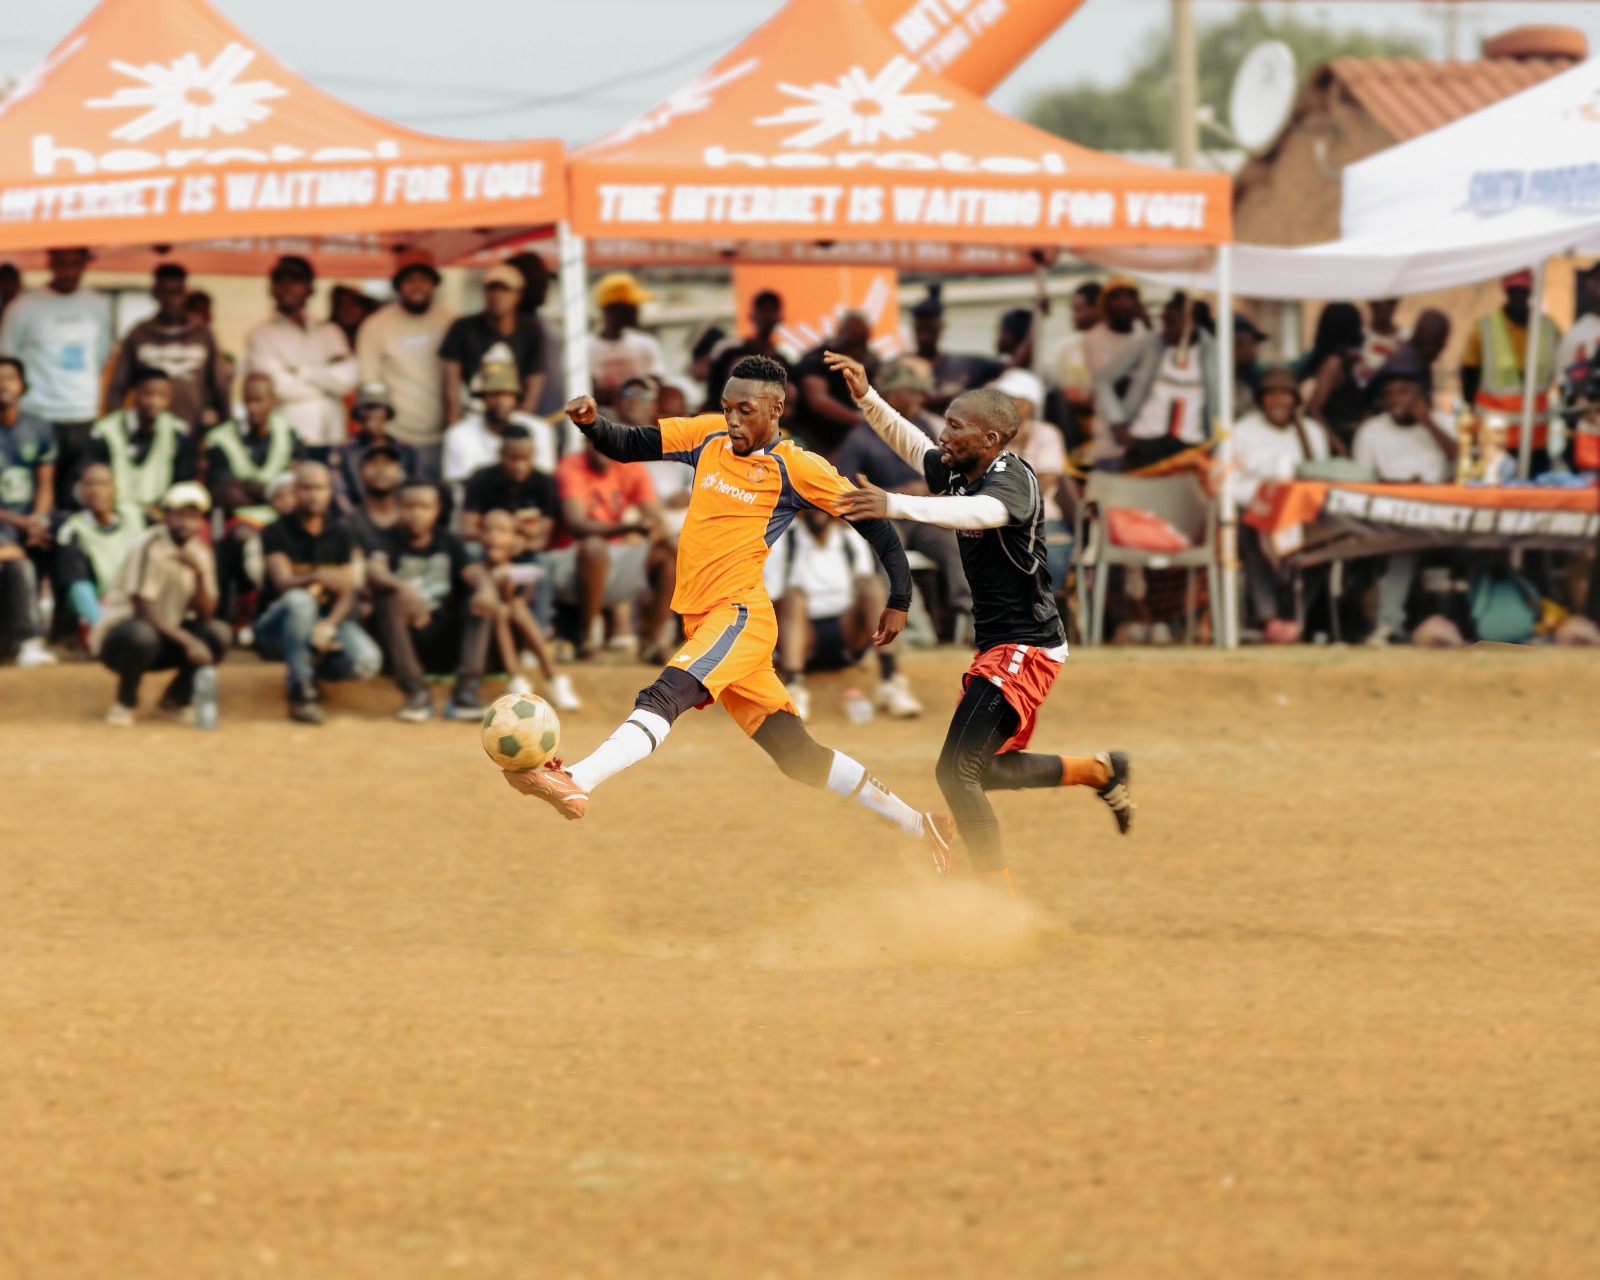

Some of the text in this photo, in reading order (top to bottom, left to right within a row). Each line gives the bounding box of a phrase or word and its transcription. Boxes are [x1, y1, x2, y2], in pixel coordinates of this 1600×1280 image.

[179, 174, 216, 214] IS
[224, 168, 376, 210] WAITING
[383, 164, 452, 205] FOR
[460, 159, 544, 200] YOU!
[596, 183, 1206, 230] THE INTERNET IS WAITING FOR YOU!
[715, 478, 758, 504] herotel
